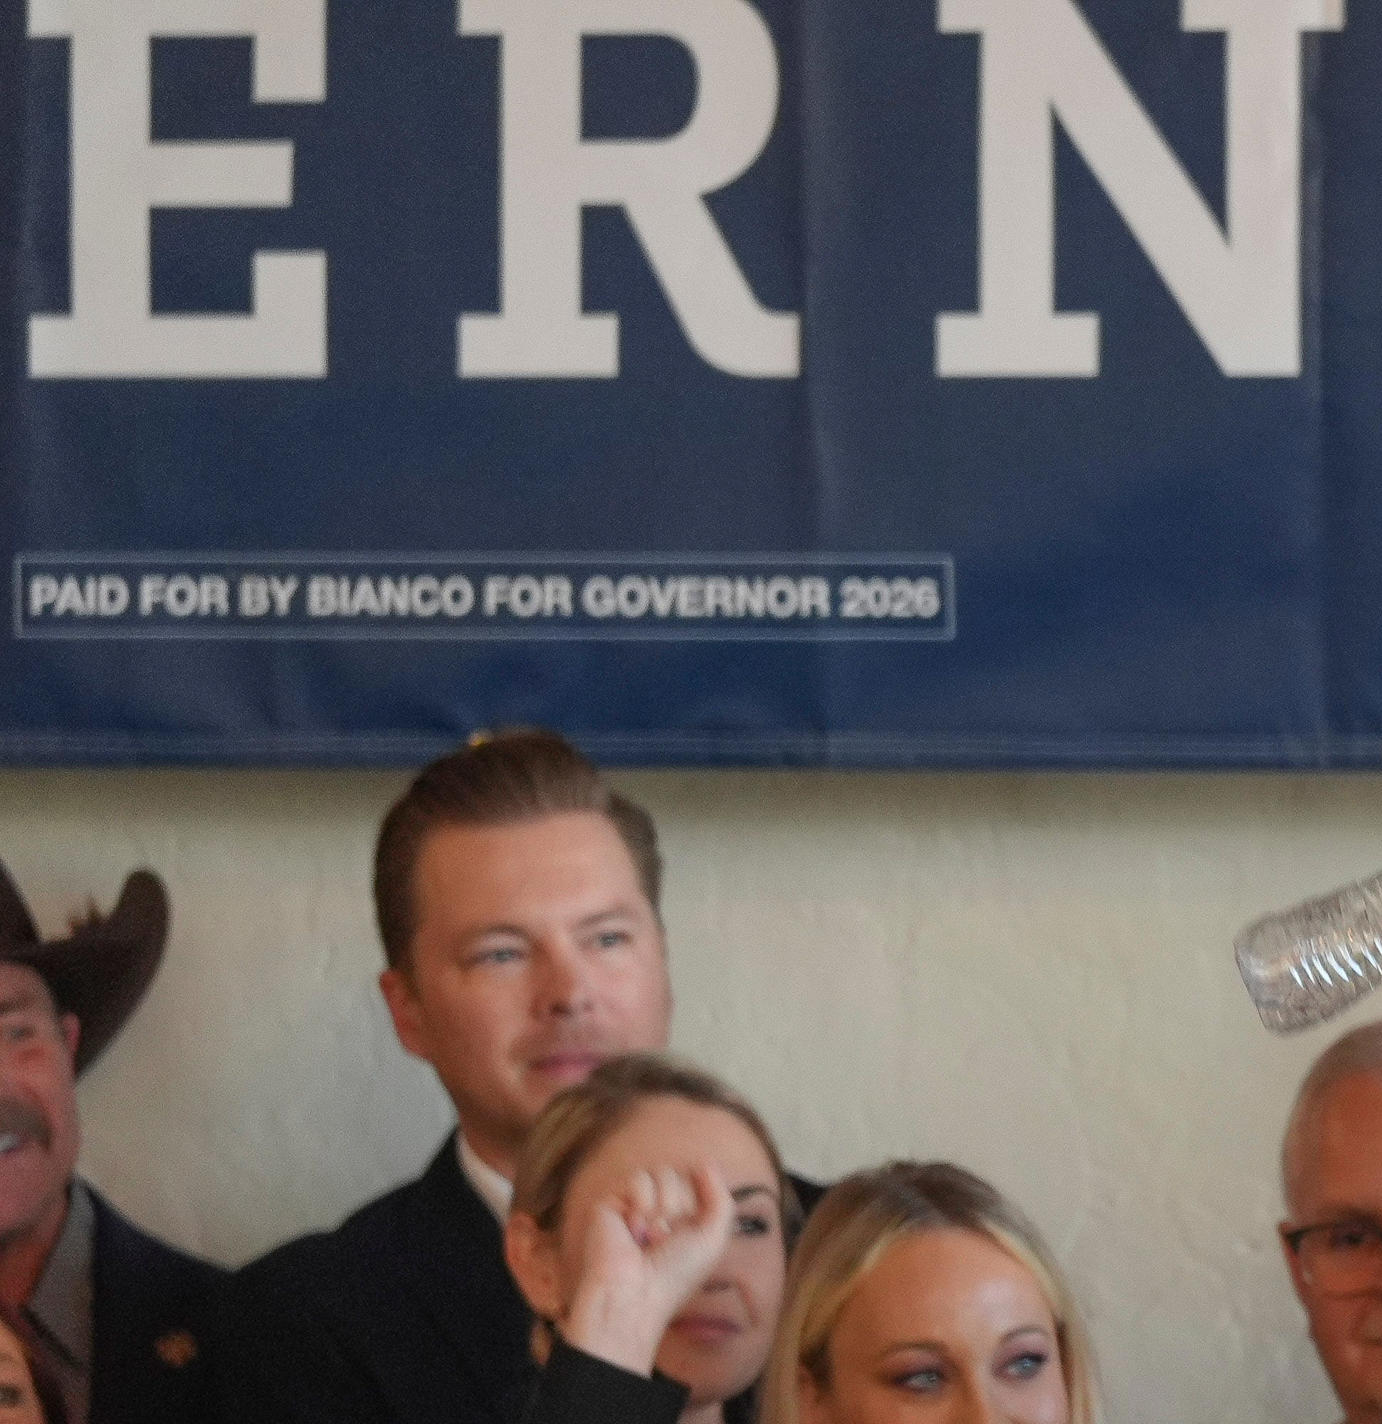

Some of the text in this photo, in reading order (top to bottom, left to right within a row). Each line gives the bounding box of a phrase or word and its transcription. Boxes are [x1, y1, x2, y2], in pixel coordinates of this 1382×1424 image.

[28, 573, 941, 620] PAID FOR BY BIANCO FOR GOVERNOR 2026
